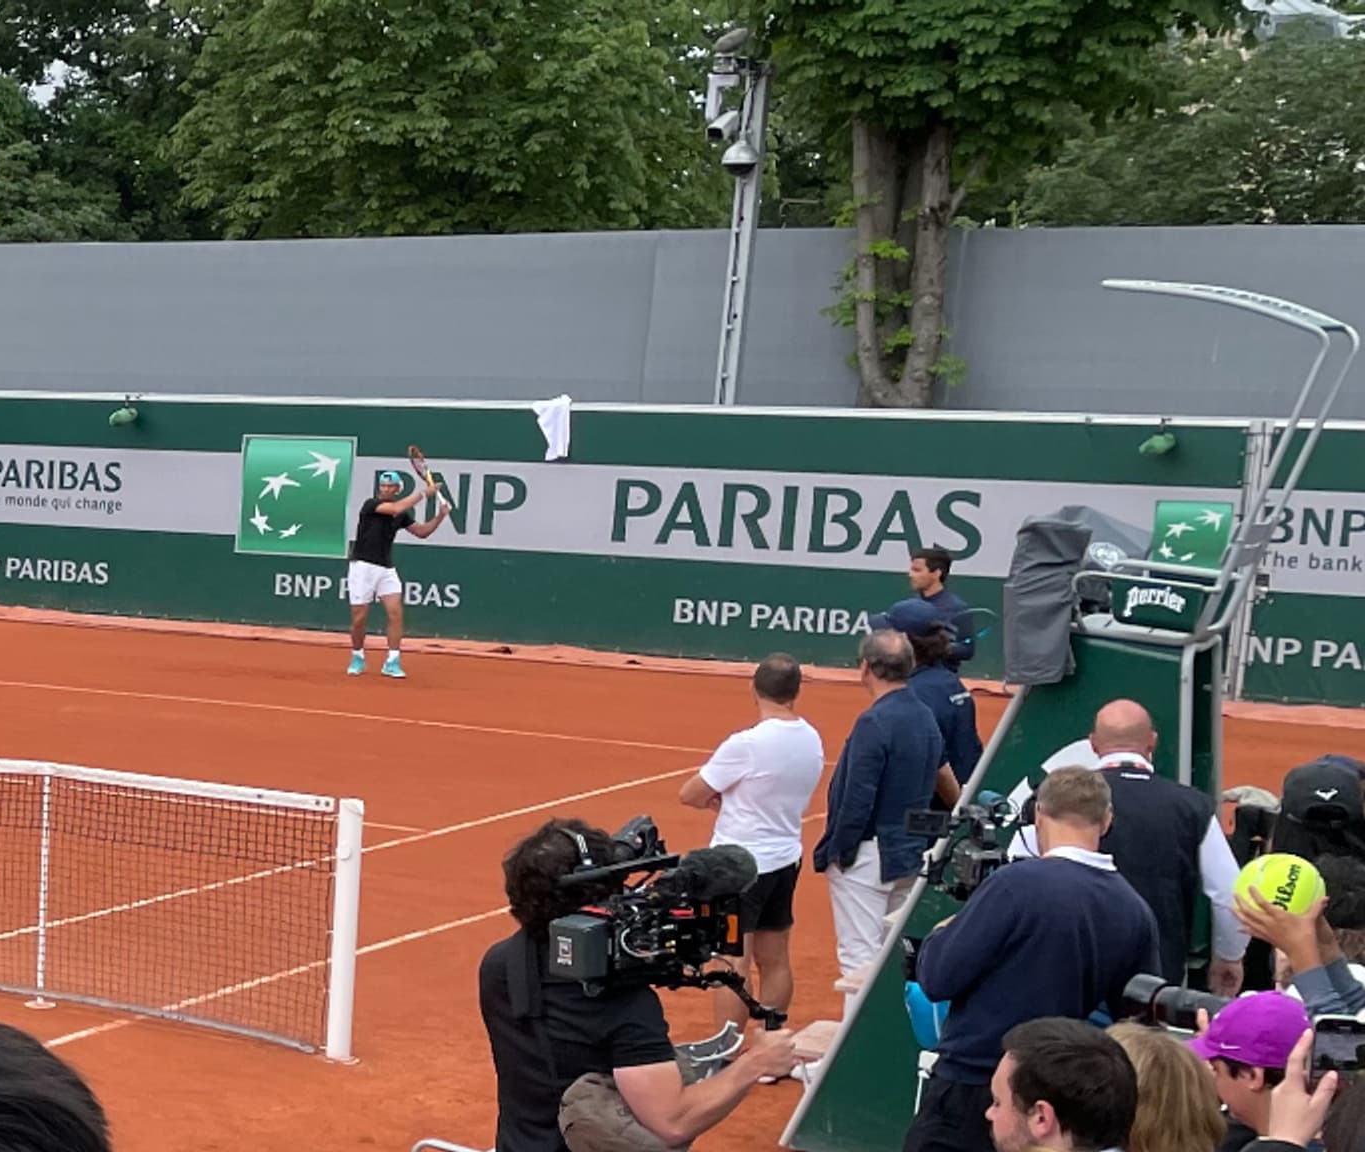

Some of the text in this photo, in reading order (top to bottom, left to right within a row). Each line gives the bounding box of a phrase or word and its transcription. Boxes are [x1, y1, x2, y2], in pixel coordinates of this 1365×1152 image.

[5, 493, 48, 508] monde
[51, 495, 72, 511] qui
[75, 496, 123, 515] change
[611, 478, 982, 561] PARIBAS
[5, 557, 109, 585] PARIBAS
[1308, 551, 1364, 573] bank
[274, 573, 461, 608] BNP PBAS
[1123, 586, 1187, 617] perrier
[673, 598, 872, 636] BNP PARIBA
[1246, 635, 1302, 665] NP
[1271, 863, 1302, 911] ilson
